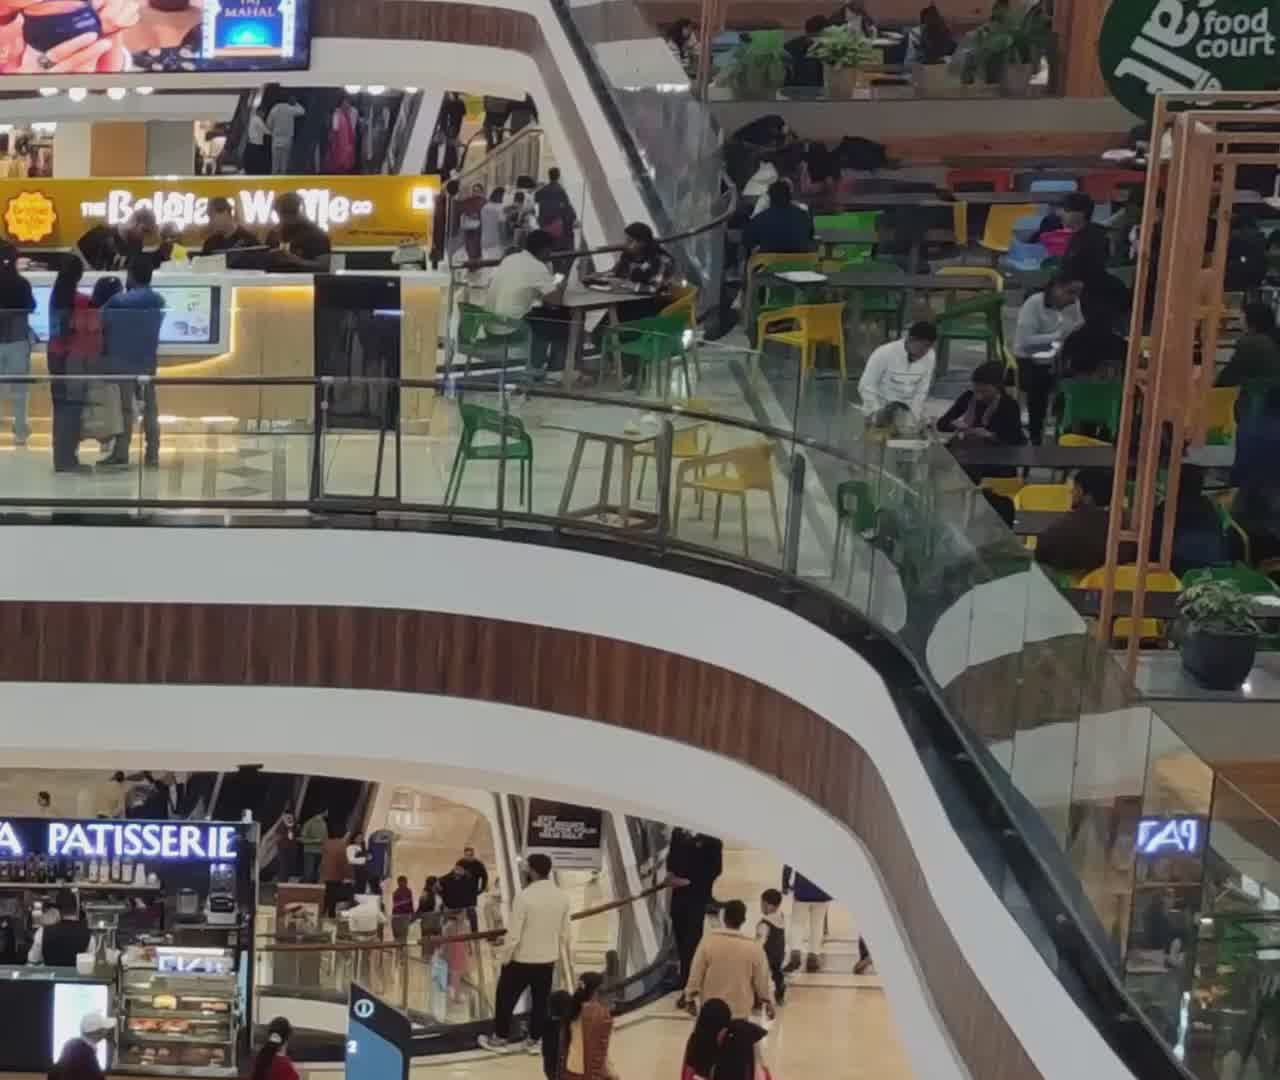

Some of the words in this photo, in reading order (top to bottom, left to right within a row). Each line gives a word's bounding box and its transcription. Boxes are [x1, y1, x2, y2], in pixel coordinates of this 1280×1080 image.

[1203, 7, 1269, 37] food
[1195, 33, 1277, 59] court
[47, 822, 239, 858] PATISSERIE
